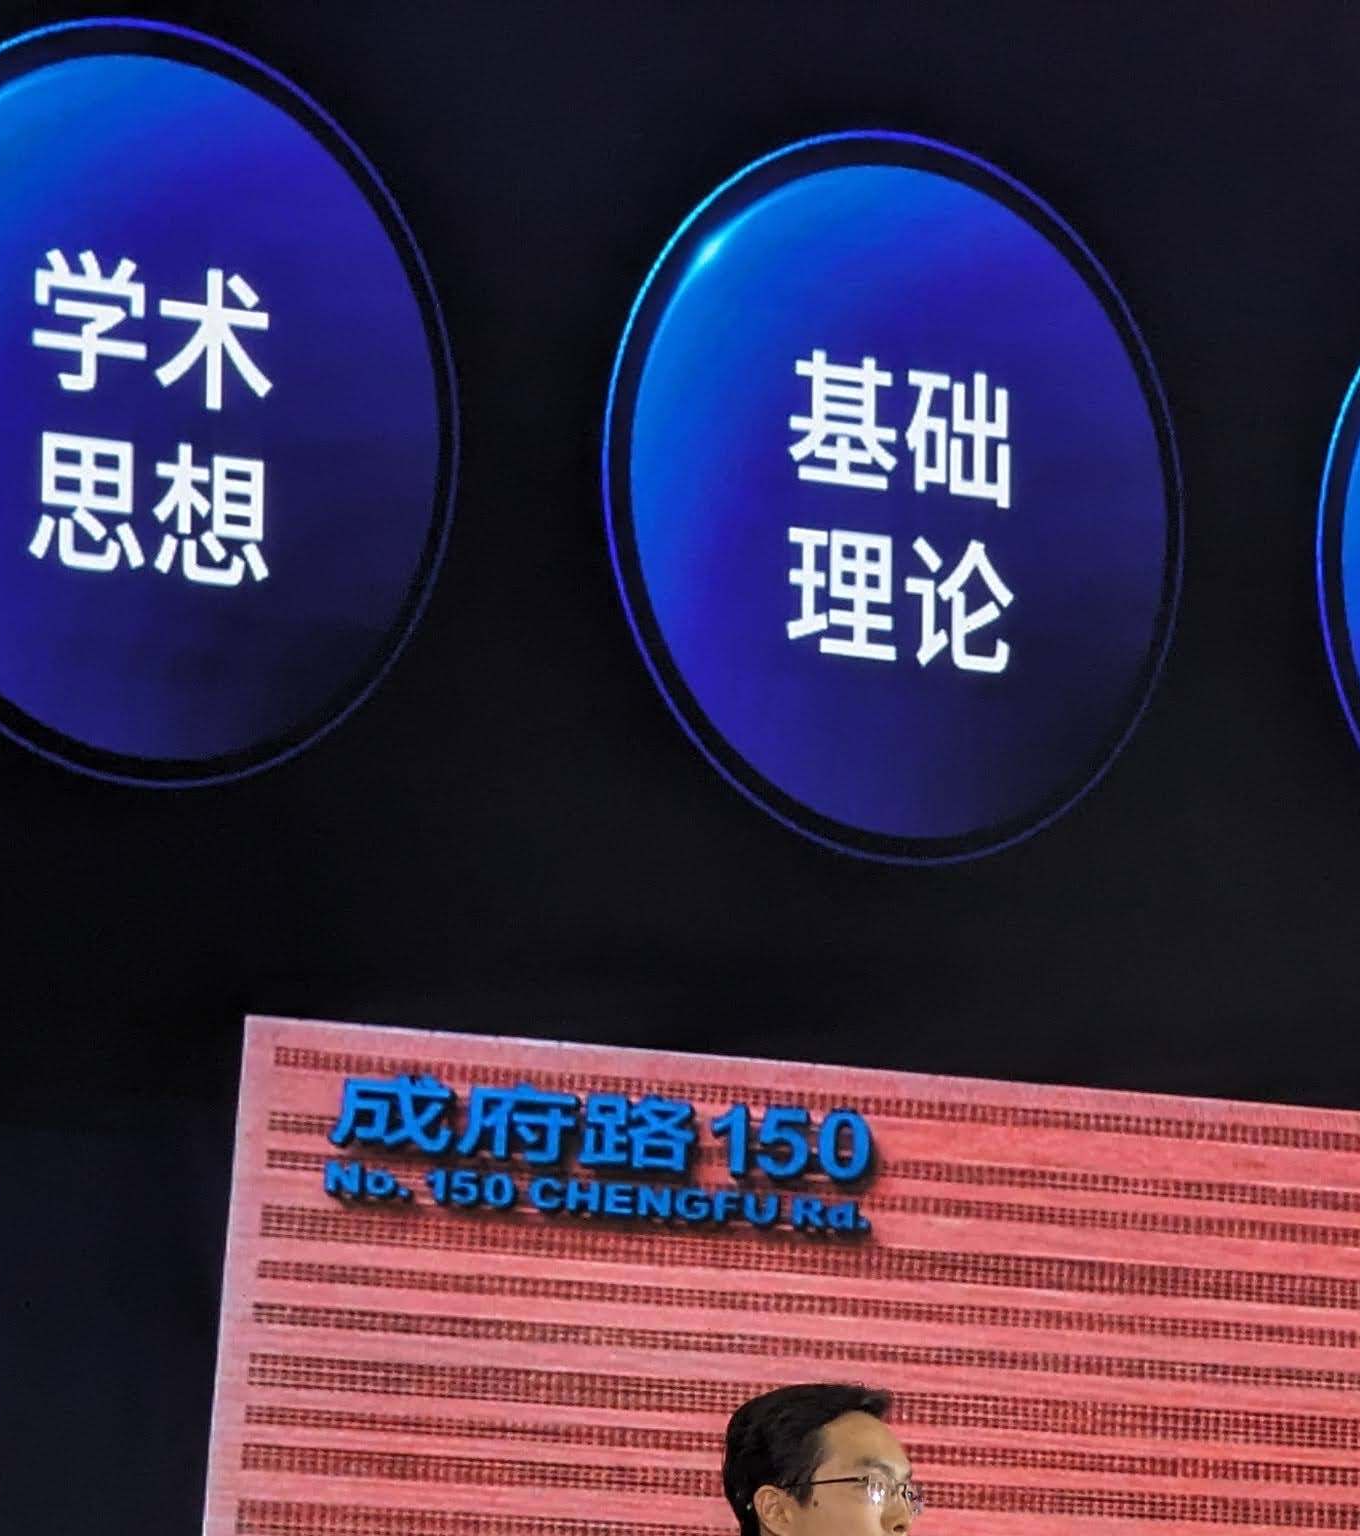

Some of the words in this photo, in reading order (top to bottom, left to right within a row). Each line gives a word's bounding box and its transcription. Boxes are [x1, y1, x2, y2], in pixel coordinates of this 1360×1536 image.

[34, 249, 273, 410] 学术
[789, 350, 1012, 509] 基础
[30, 431, 269, 587] 思想
[787, 527, 1014, 674] 理论
[324, 1161, 412, 1200] No.
[427, 1169, 515, 1208] 150
[528, 1177, 778, 1226] CHENGFU
[790, 1198, 871, 1231] Rd.
